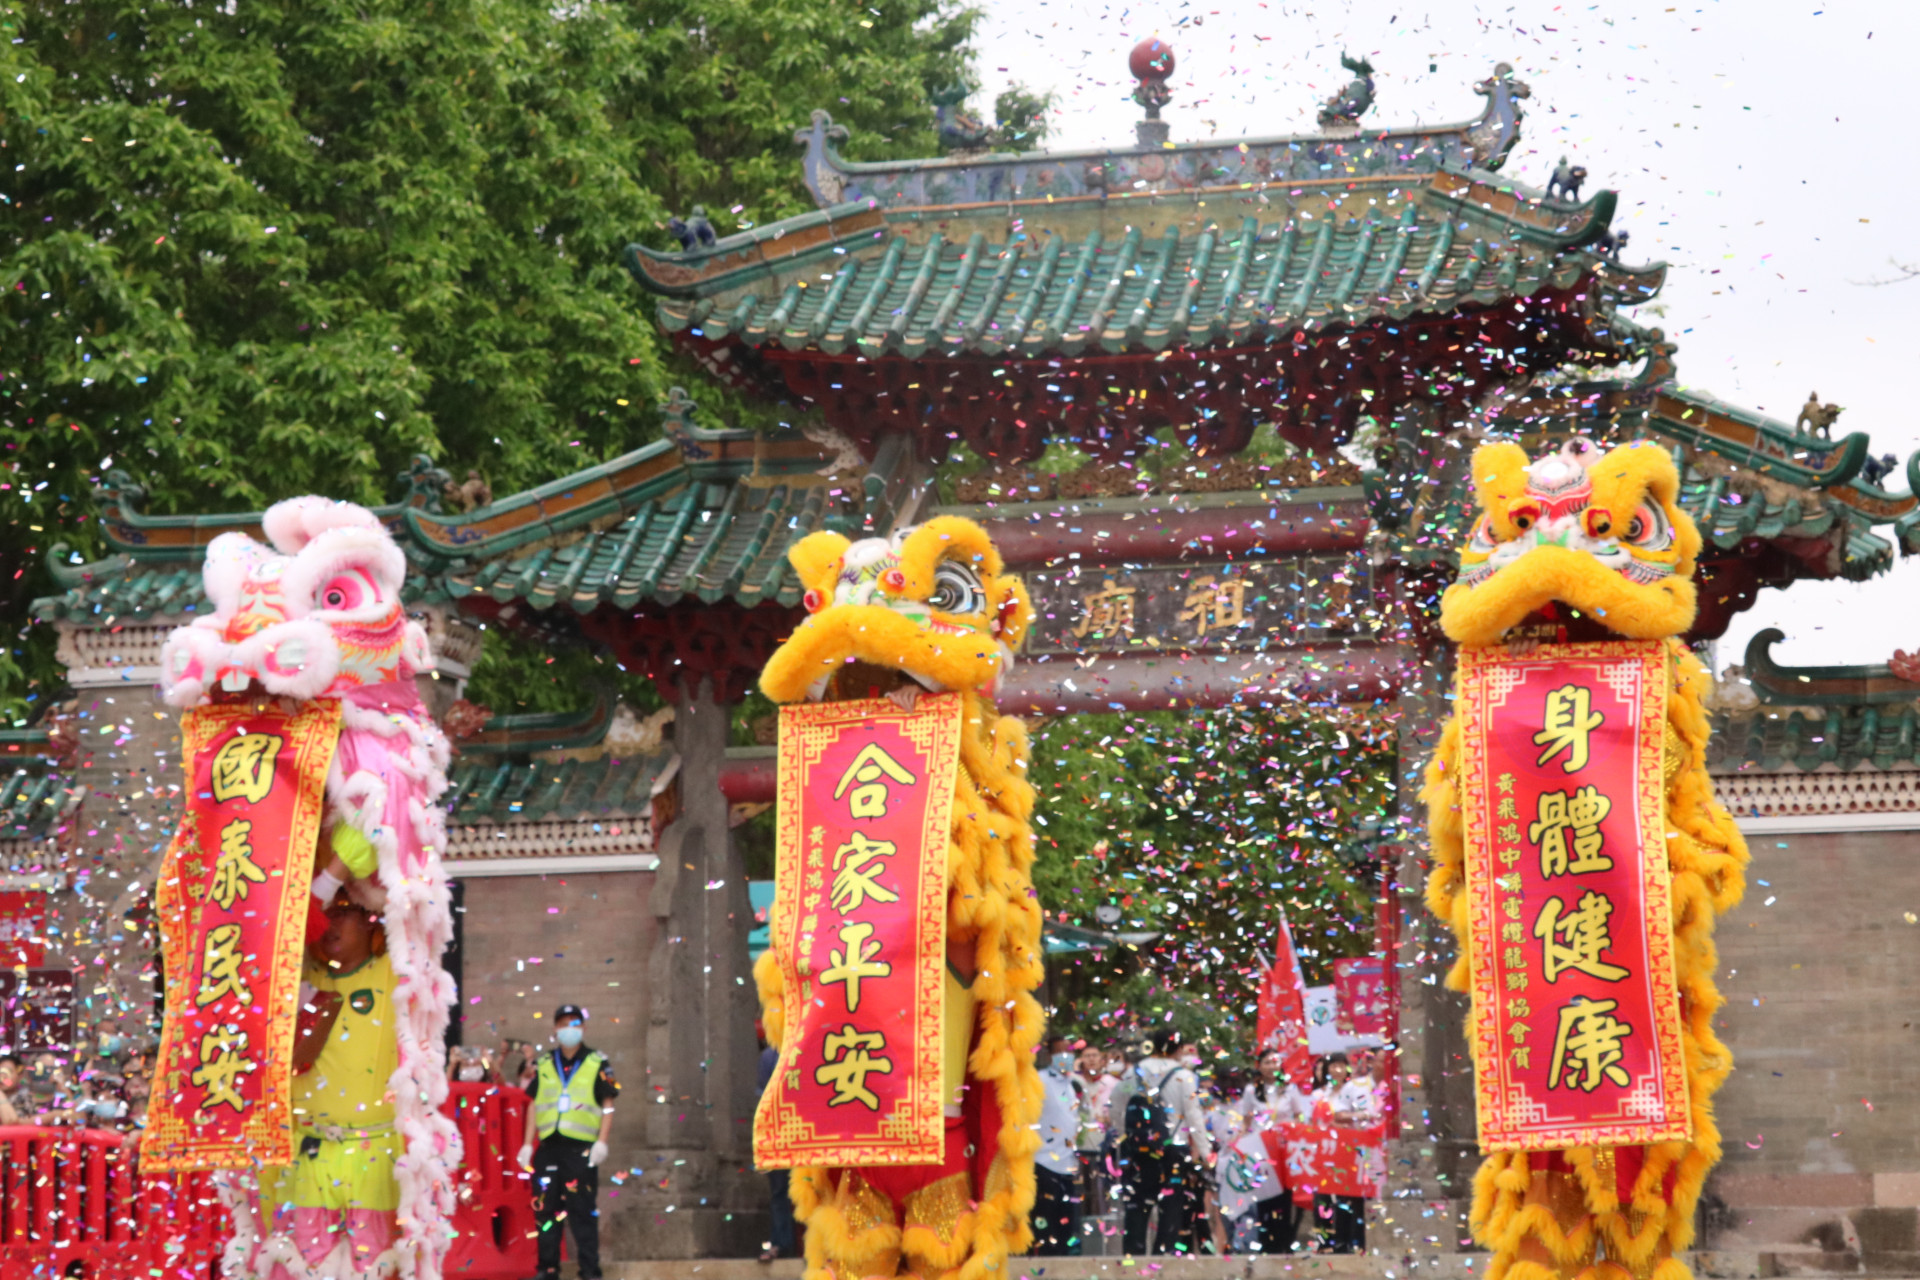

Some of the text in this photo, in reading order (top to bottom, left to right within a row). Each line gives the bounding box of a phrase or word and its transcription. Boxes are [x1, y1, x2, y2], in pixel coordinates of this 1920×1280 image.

[191, 732, 283, 1113] 國泰民安
[815, 742, 917, 1111] 合家平安
[1528, 683, 1633, 1093] 身體健康
